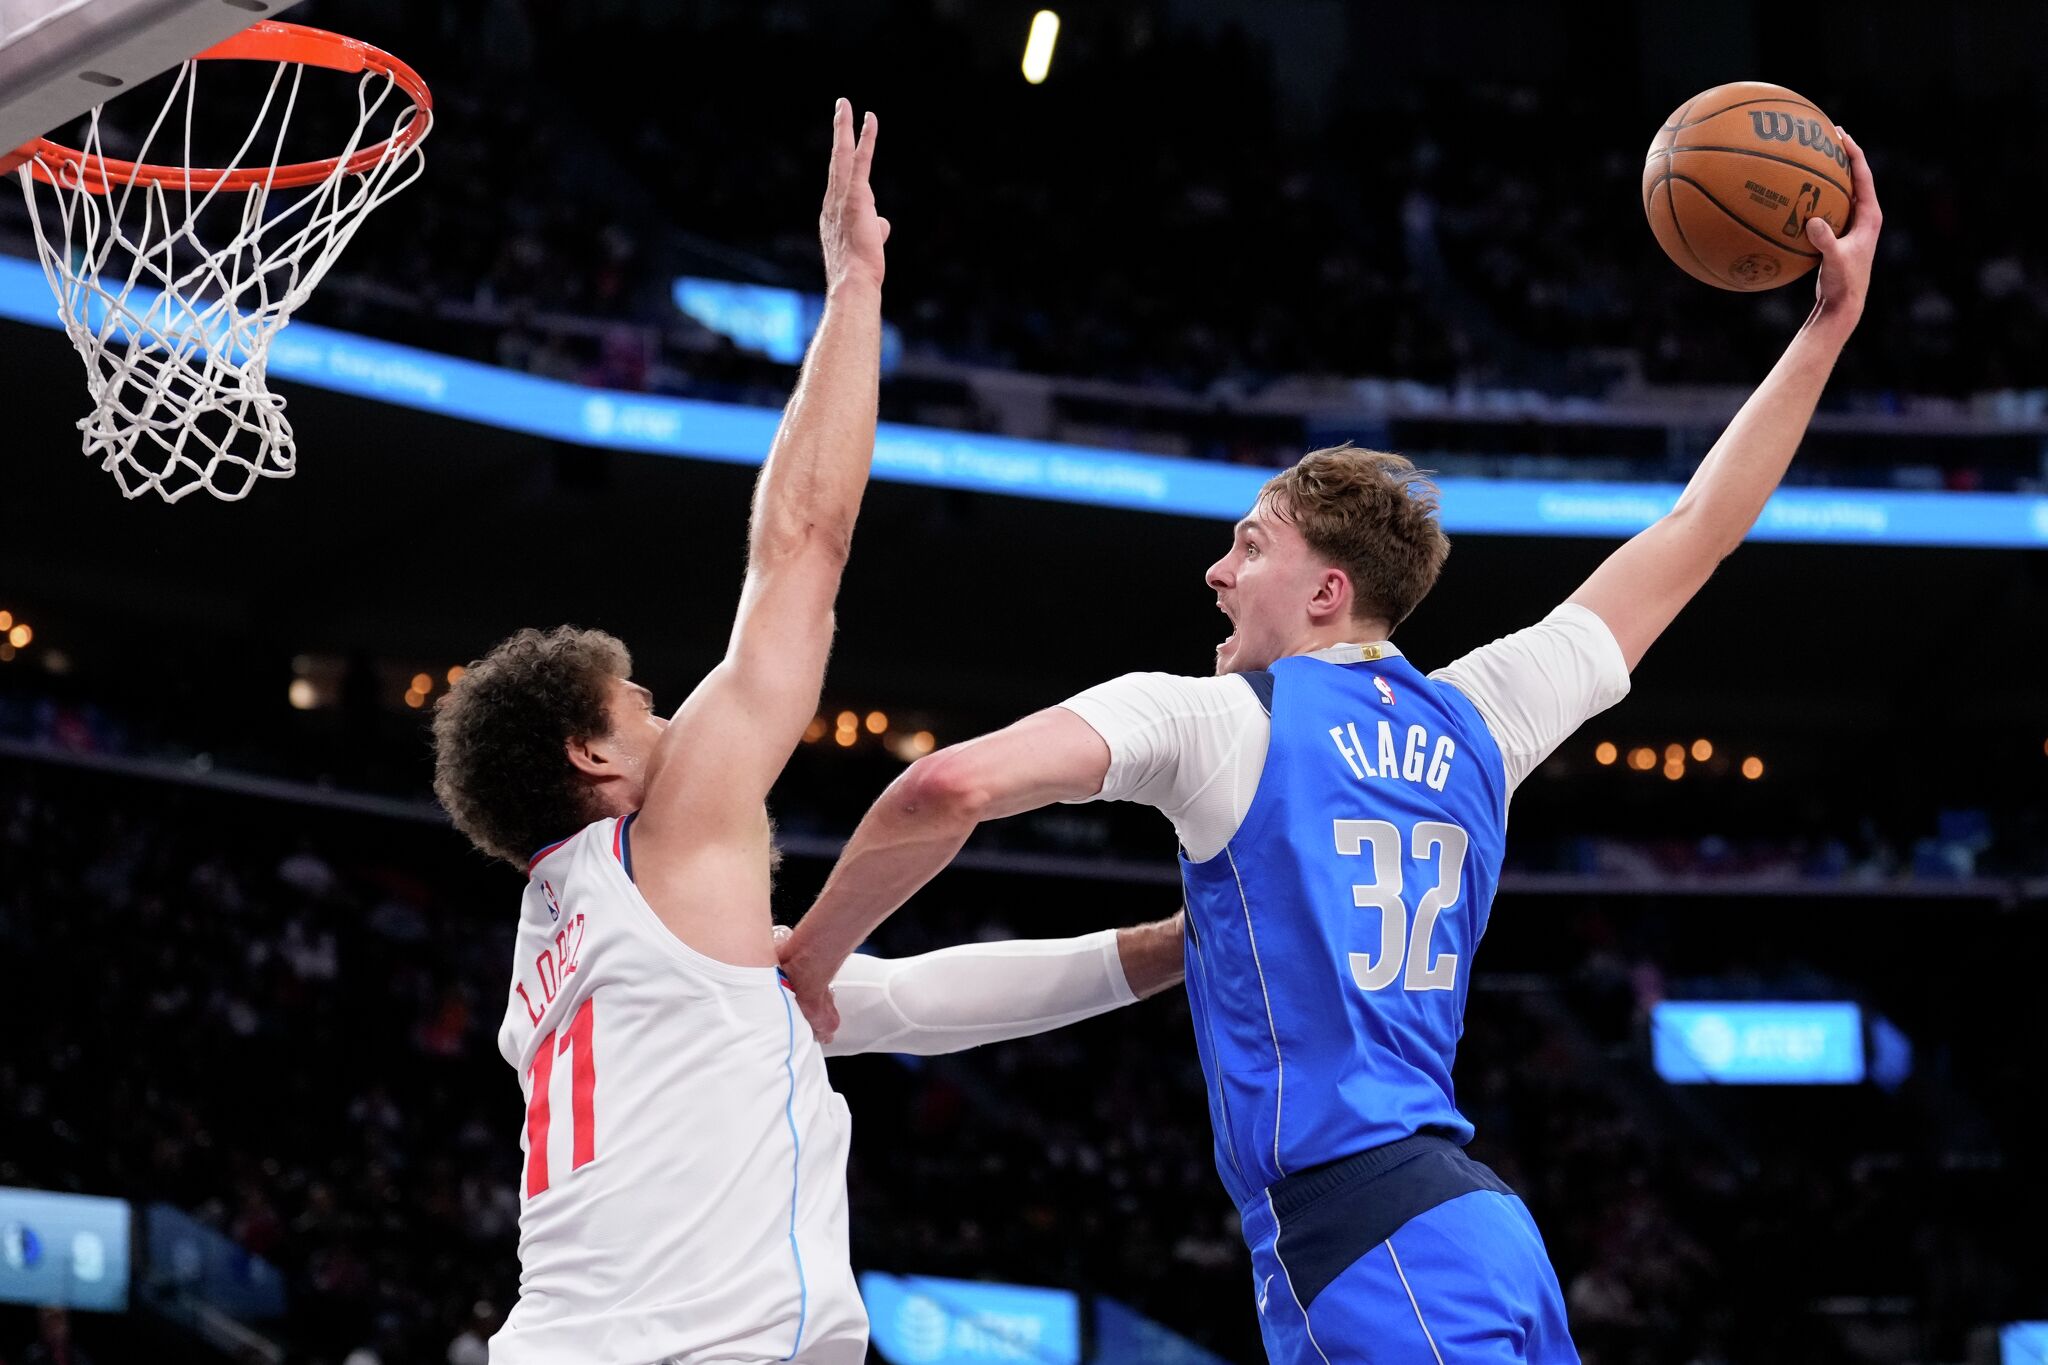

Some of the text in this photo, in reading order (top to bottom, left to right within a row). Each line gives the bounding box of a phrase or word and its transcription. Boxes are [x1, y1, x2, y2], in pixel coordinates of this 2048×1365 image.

[1328, 720, 1455, 793] FLAGG
[515, 913, 584, 1029] LOPEZ
[1333, 819, 1469, 991] 32
[527, 996, 595, 1200] 11
